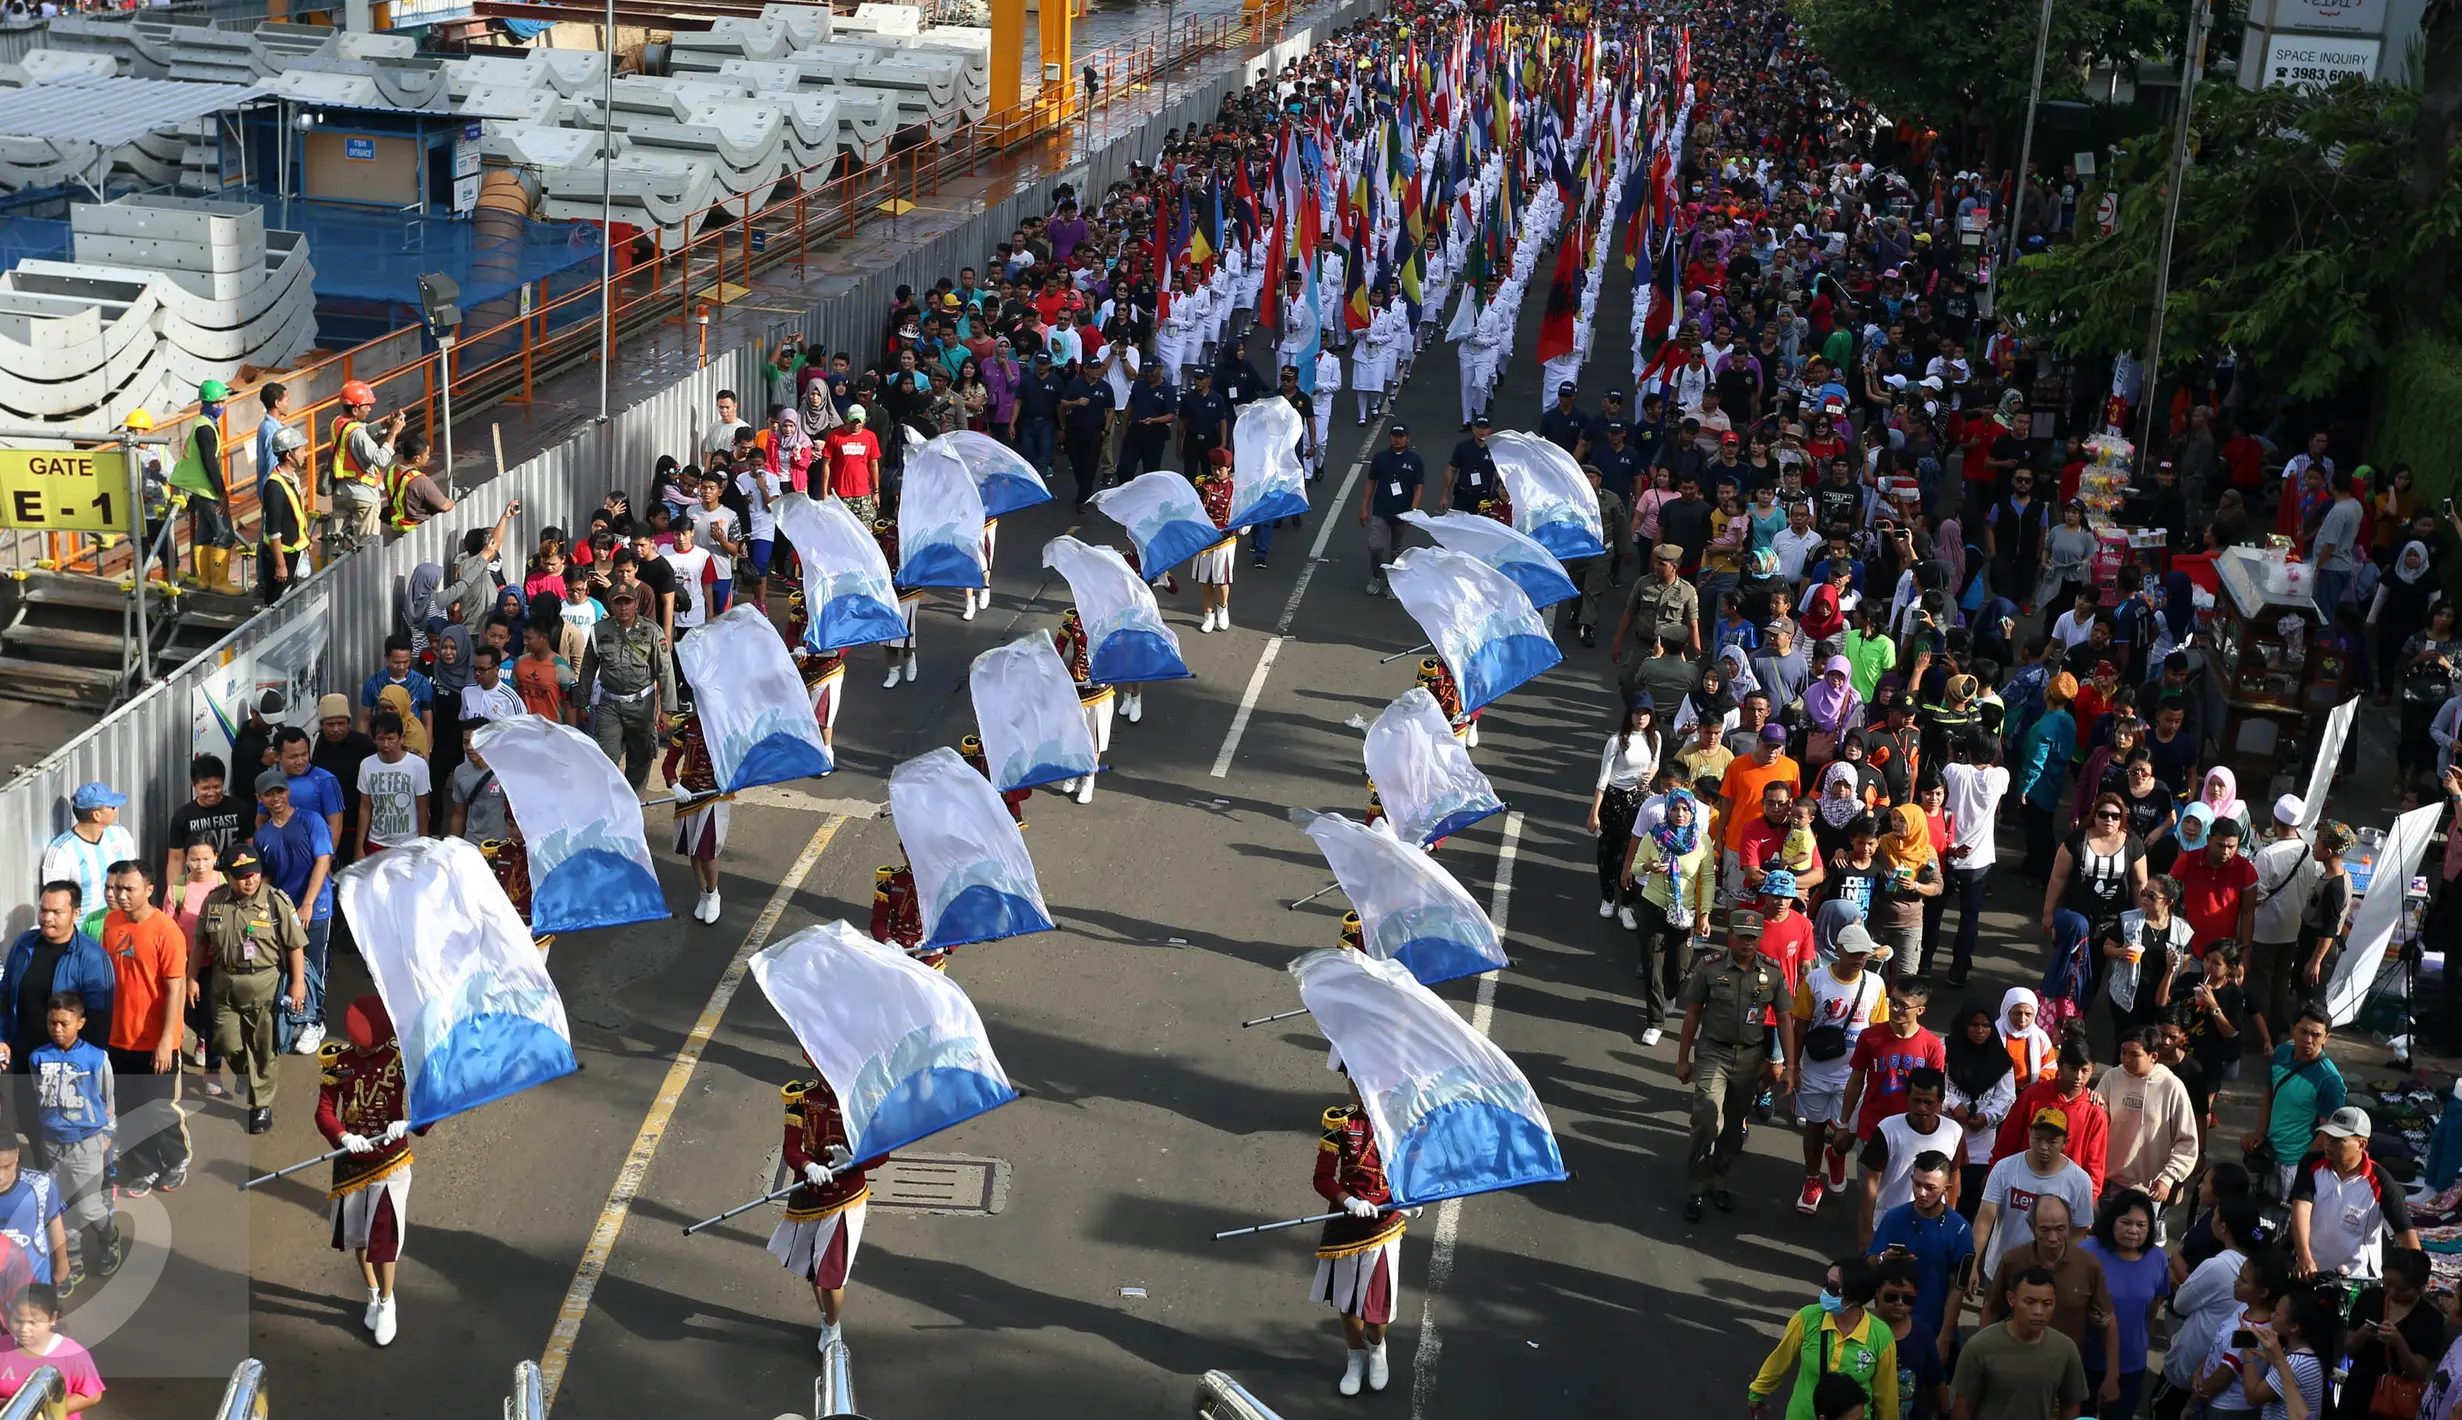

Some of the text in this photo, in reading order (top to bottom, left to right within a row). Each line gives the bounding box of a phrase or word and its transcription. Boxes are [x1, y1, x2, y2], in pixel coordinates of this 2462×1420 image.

[2276, 49, 2368, 65] SPACE INQUIRY
[2292, 67, 2363, 81] 3983 60
[29, 457, 93, 476] GATE
[13, 491, 45, 522] E
[92, 493, 112, 524] 1
[563, 614, 590, 625] VADA
[370, 772, 411, 792] PETER
[190, 814, 238, 831] RUN FAST
